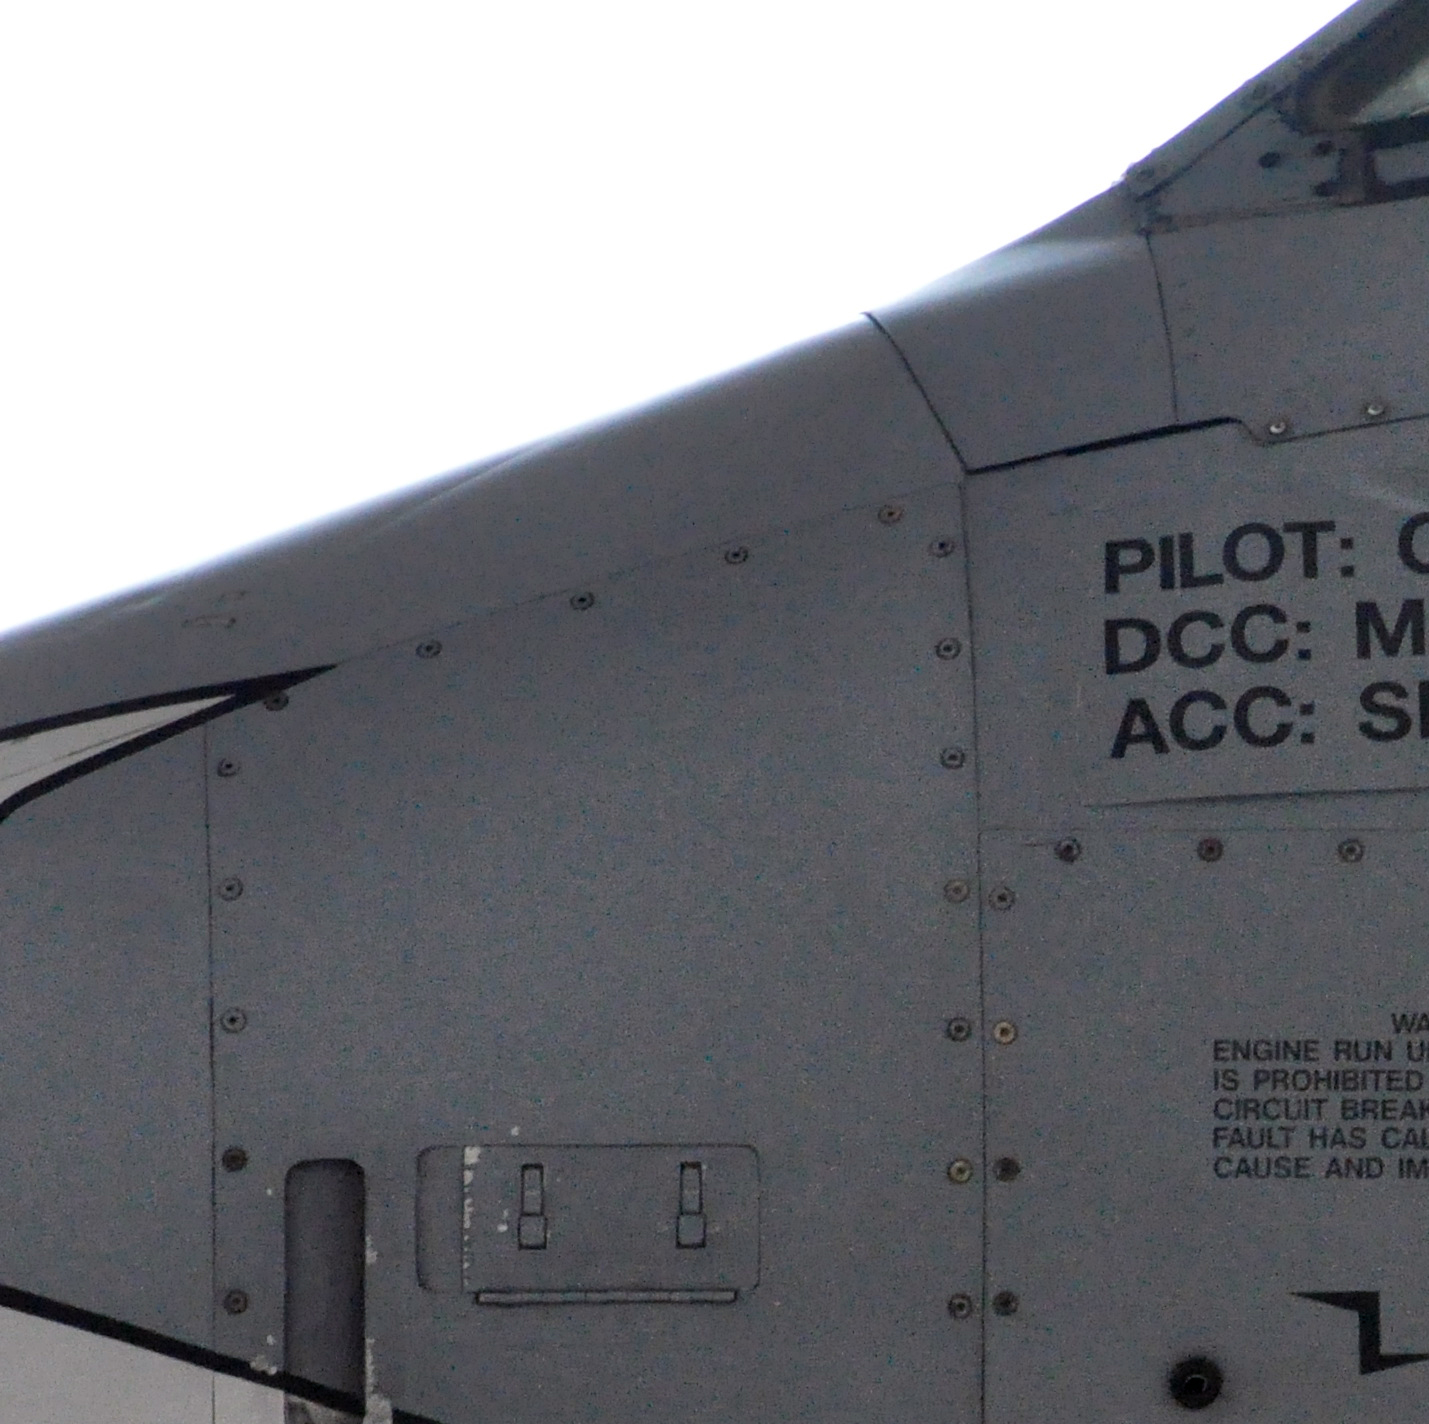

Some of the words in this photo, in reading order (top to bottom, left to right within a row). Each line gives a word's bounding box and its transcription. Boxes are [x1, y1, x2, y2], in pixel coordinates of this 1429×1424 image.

[1104, 520, 1355, 594] PILOT:
[1104, 603, 1312, 675] DCC:
[1110, 685, 1315, 759] ACC:
[1213, 1039, 1321, 1063] ENGINE
[1334, 1039, 1394, 1063] RUN
[1213, 1069, 1240, 1093] IS
[1253, 1069, 1425, 1093] PROHIBITED
[1212, 1098, 1329, 1122] CIRCUIT
[1212, 1127, 1296, 1151] FAULT
[1309, 1127, 1367, 1151] HAS
[1213, 1156, 1312, 1181] CAUSE
[1325, 1156, 1384, 1181] AND
